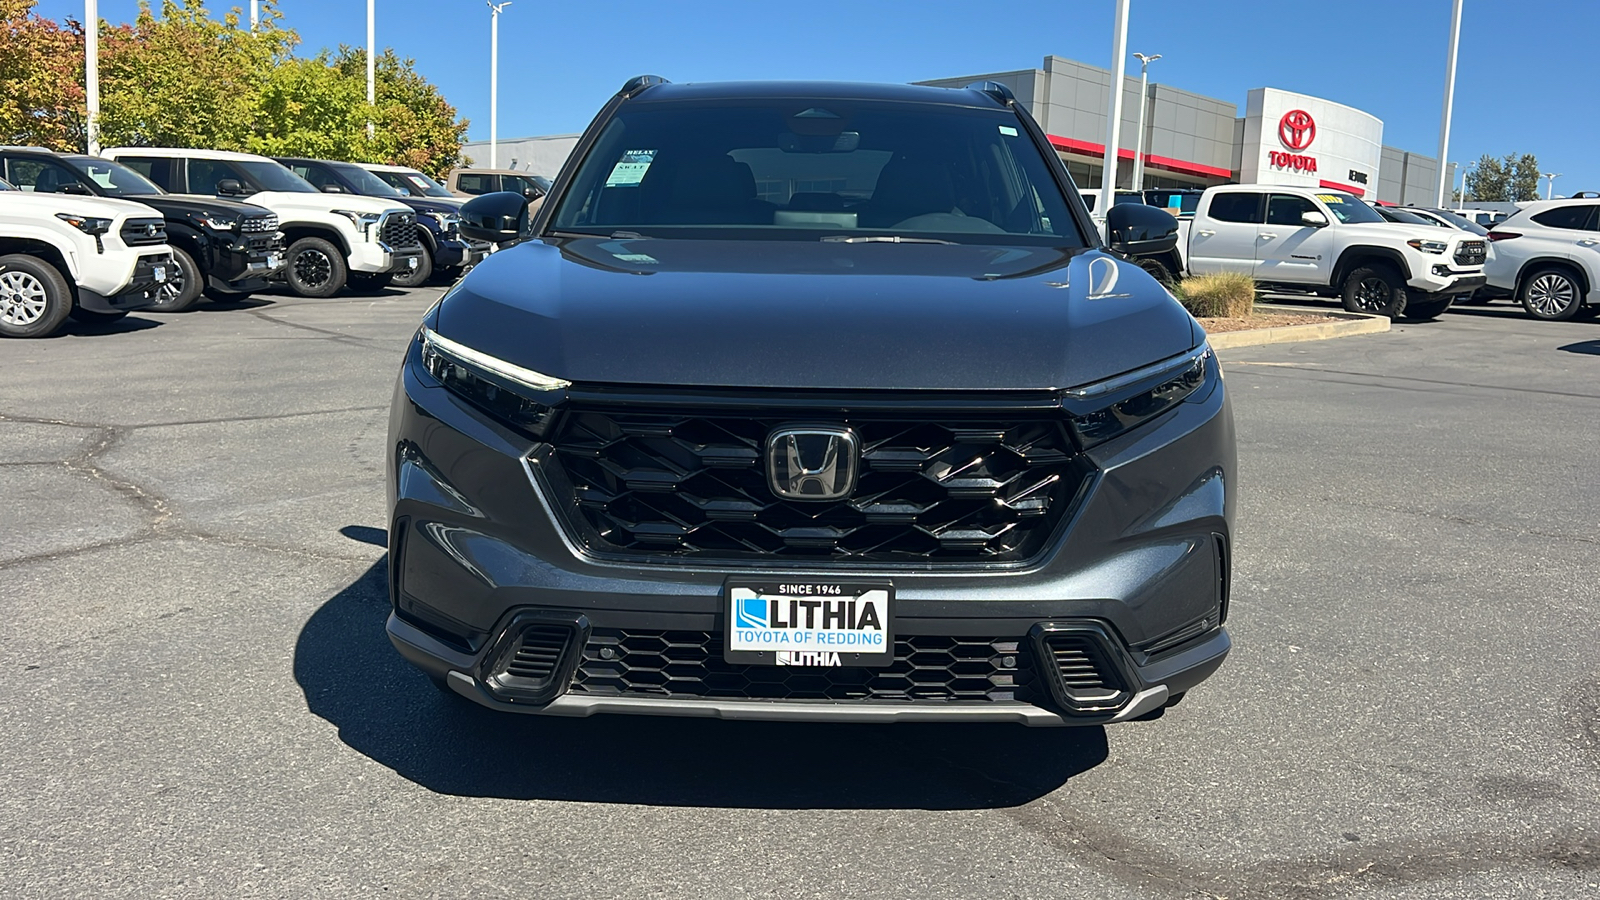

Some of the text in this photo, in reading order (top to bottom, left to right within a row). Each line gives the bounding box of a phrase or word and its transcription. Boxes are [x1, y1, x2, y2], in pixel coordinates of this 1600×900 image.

[1269, 151, 1317, 172] TOYOTA
[779, 584, 841, 595] SINCE 1946
[770, 600, 881, 630] LITHIA
[736, 631, 882, 645] TOYOTA OF REDDING
[791, 652, 842, 666] LITHIA
